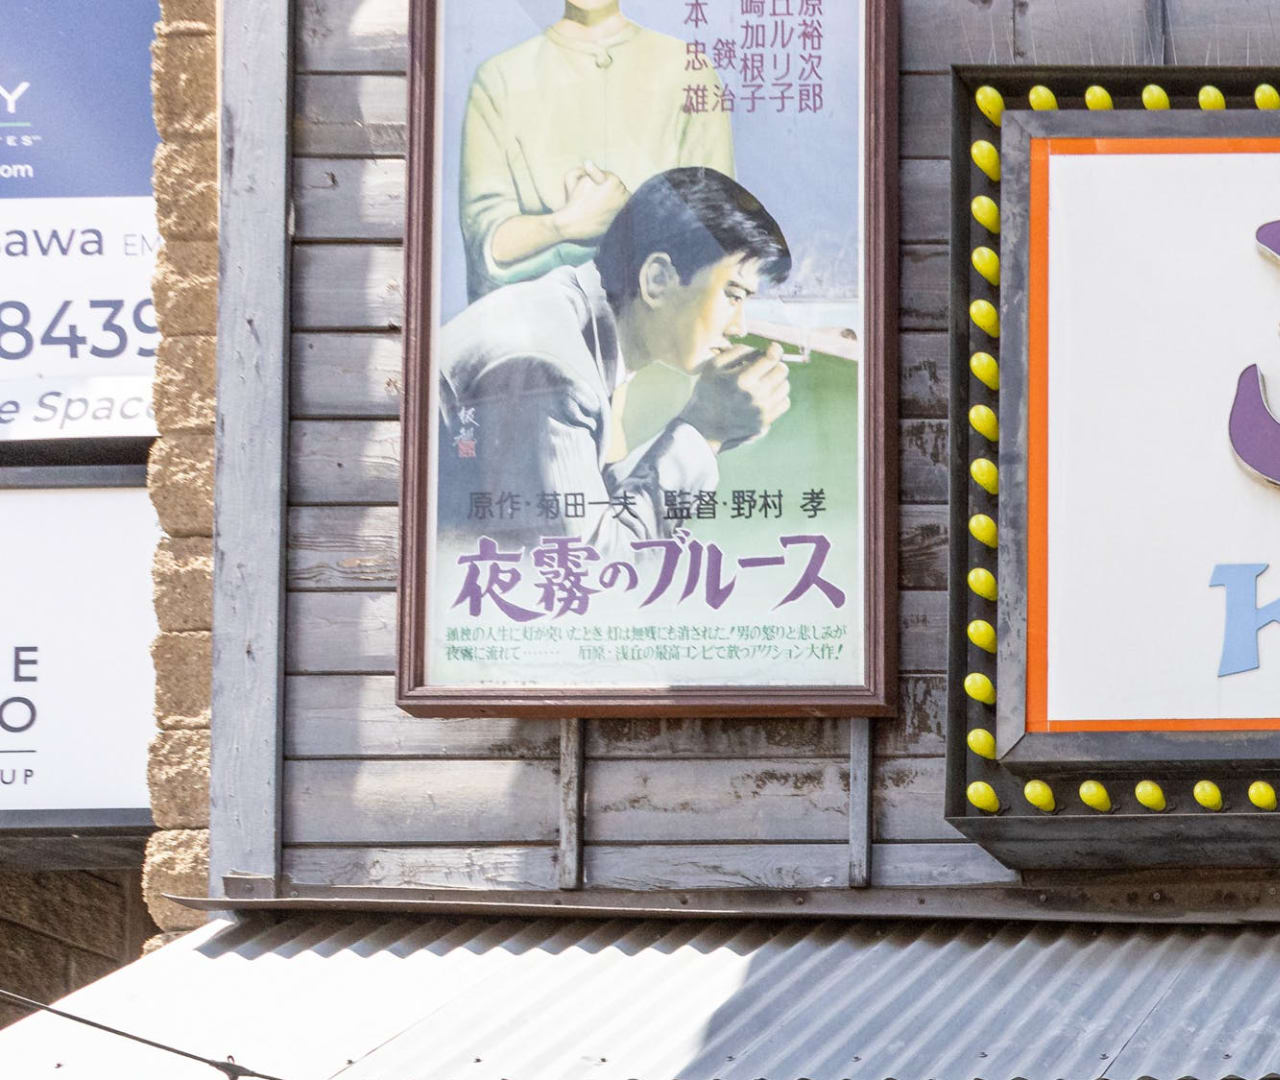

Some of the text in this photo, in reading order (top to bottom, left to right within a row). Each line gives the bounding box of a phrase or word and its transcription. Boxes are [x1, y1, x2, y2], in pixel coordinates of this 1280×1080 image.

[5, 229, 104, 257] awa
[451, 529, 846, 623] 夜霧のブルース
[14, 646, 38, 682] E
